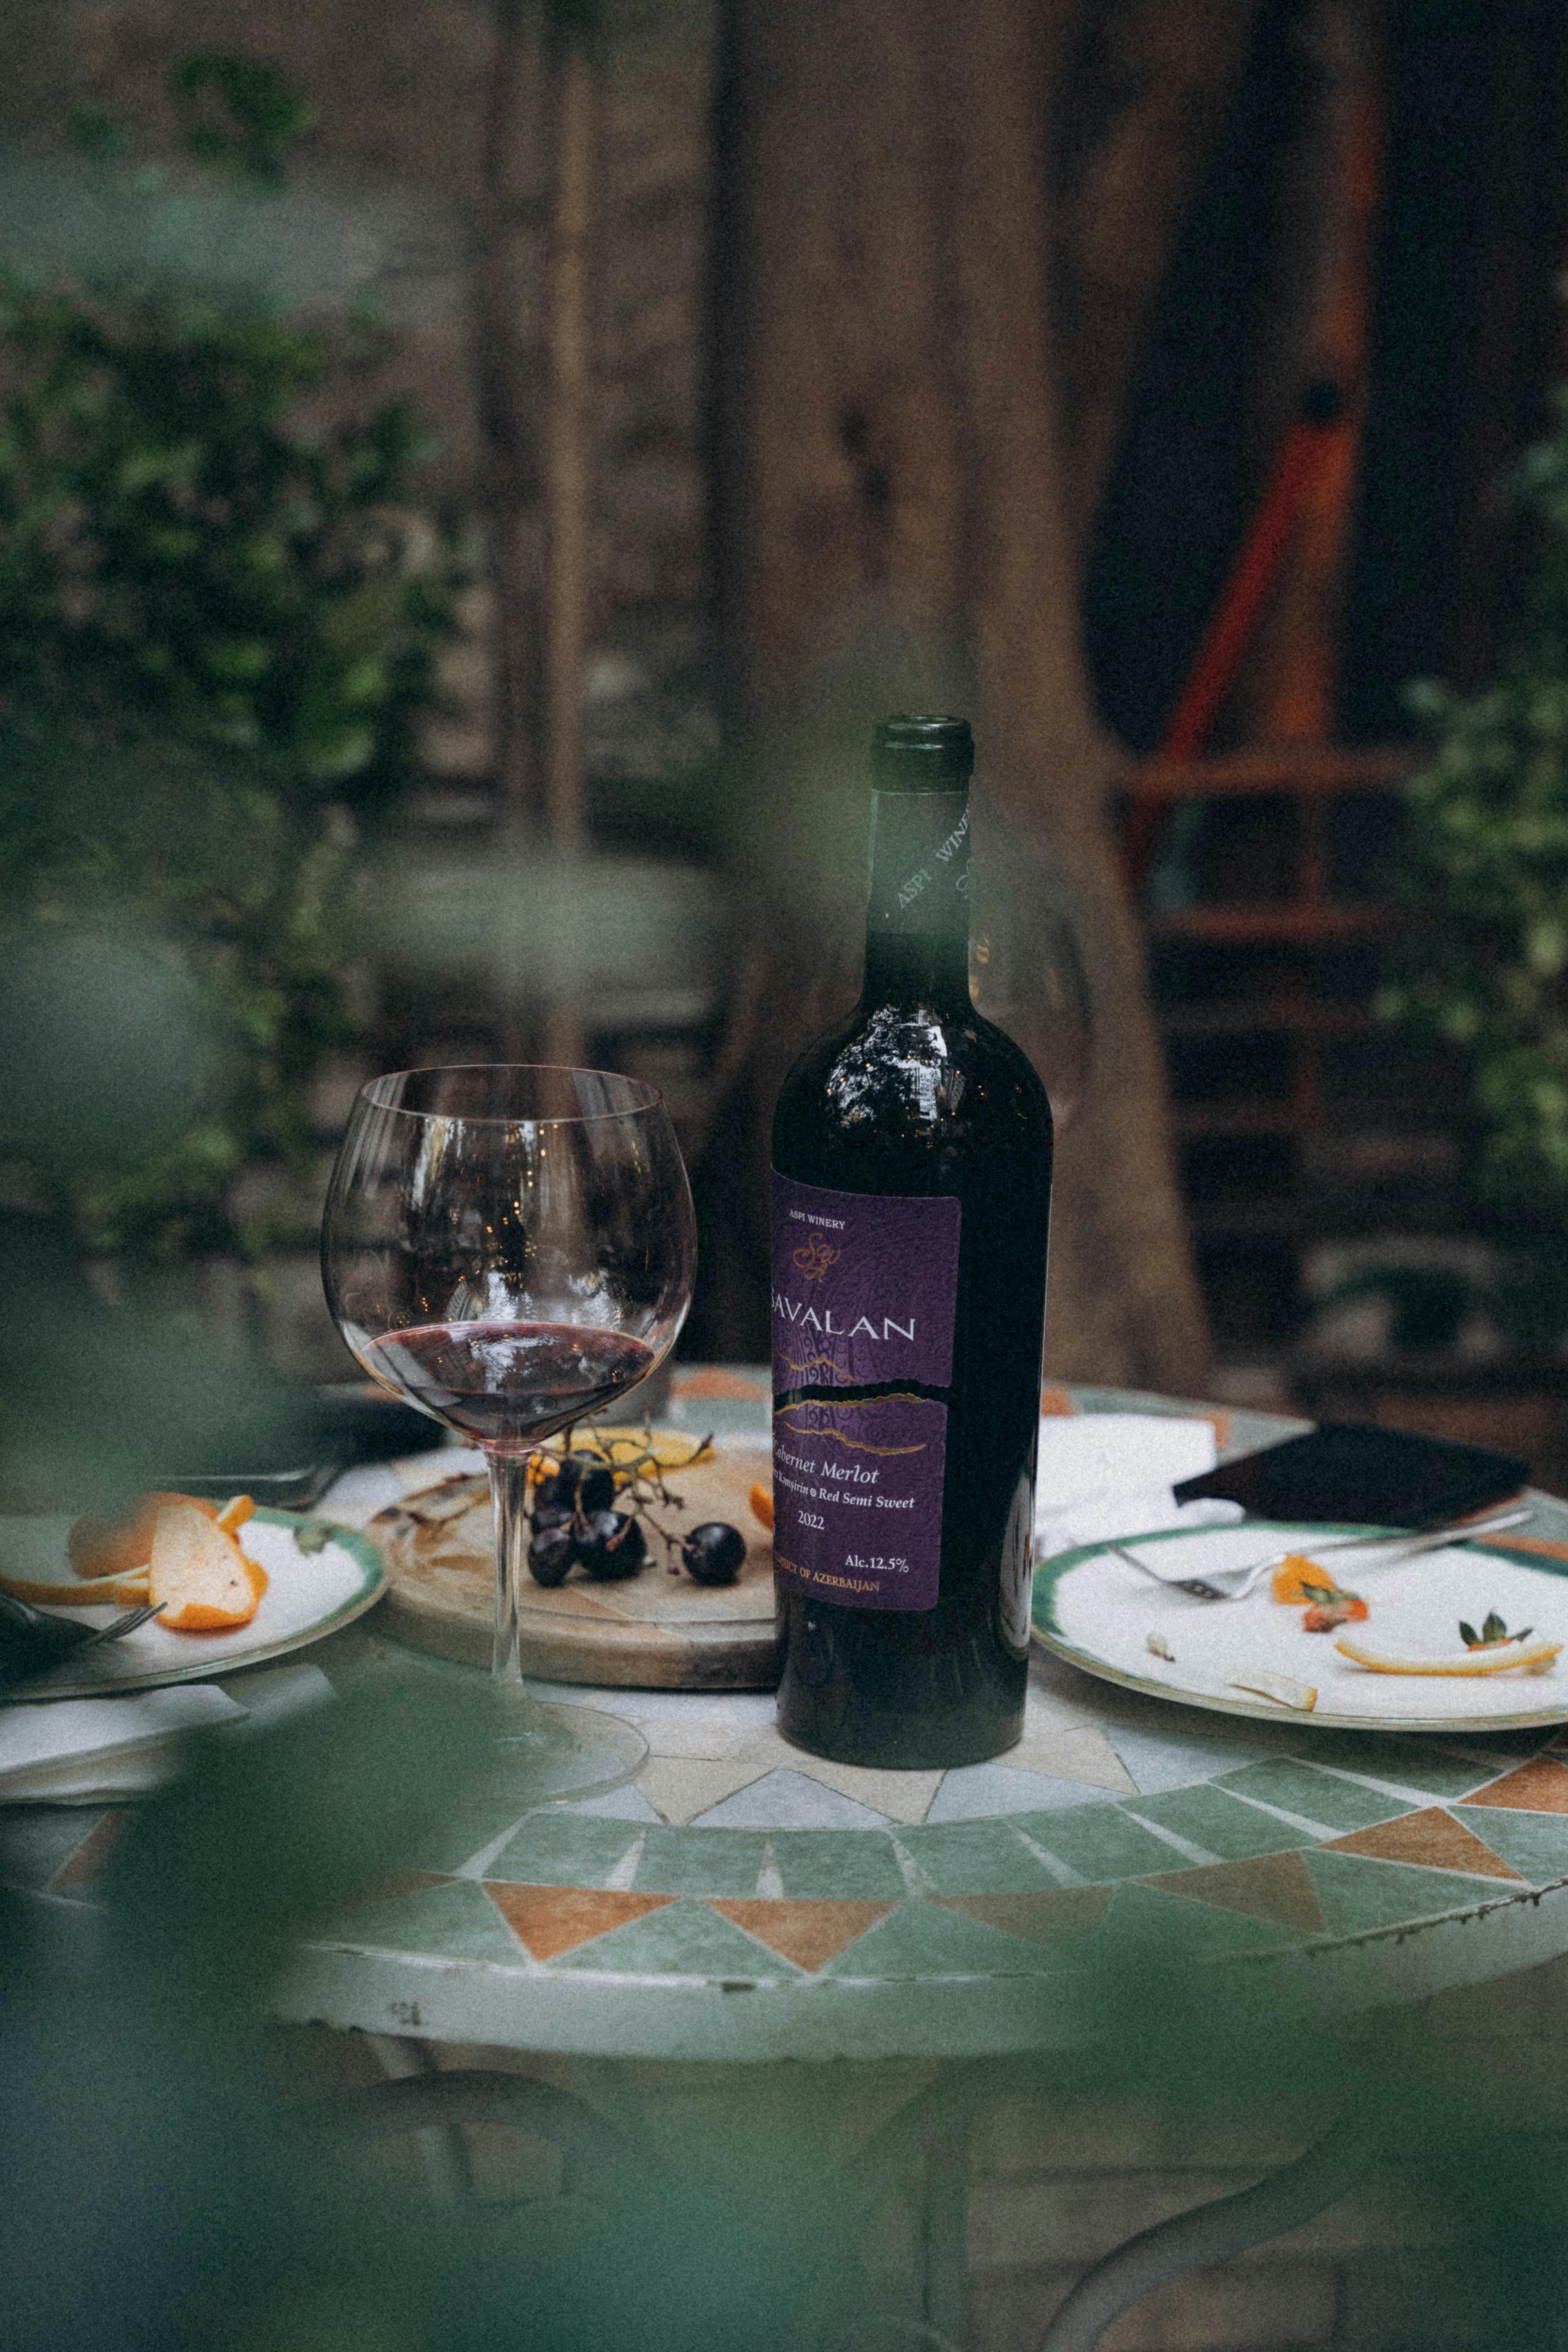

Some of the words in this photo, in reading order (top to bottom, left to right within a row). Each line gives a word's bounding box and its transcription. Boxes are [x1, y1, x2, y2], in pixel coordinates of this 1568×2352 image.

[898, 868, 932, 908] ASPI
[789, 1209, 805, 1221] ASPI
[807, 1214, 846, 1230] WINERY
[774, 1439, 816, 1474] Cabernet
[820, 1461, 880, 1484] Merlot
[819, 1488, 840, 1503] Red
[843, 1492, 873, 1507] Semi
[876, 1495, 915, 1508] Sweet
[798, 1510, 825, 1530] 2022
[799, 1567, 811, 1579] OF
[813, 1571, 880, 1593] AZERBAIJAN
